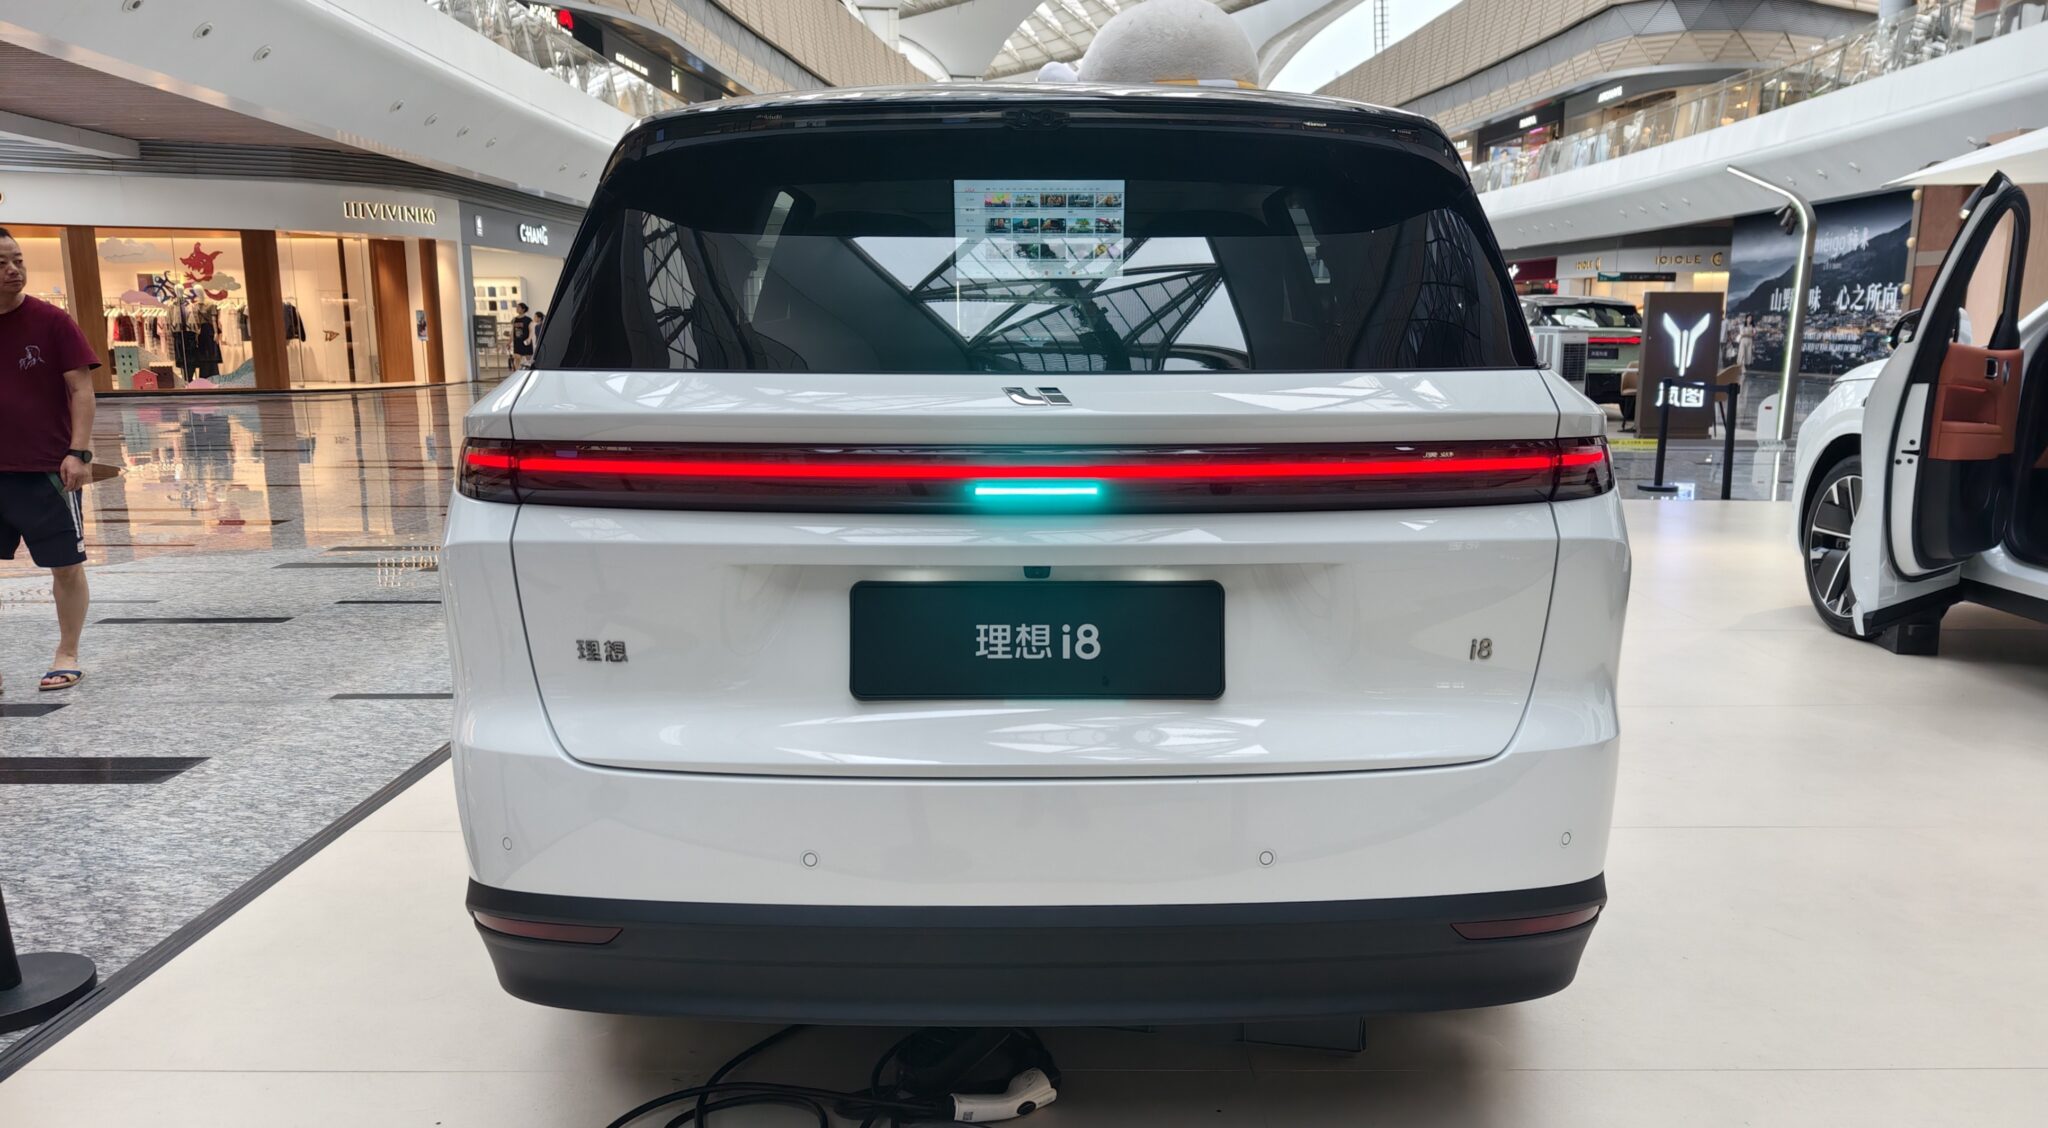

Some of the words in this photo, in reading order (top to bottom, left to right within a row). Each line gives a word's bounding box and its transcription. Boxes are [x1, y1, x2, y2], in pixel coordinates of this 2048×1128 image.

[1655, 255, 1701, 265] ICICLE
[1770, 285, 1821, 312] 山野味
[1836, 282, 1898, 312] 心之所向
[576, 639, 629, 662] 理想
[975, 623, 1053, 660] 理想
[1062, 623, 1101, 660] i8
[1469, 638, 1493, 660] i8
